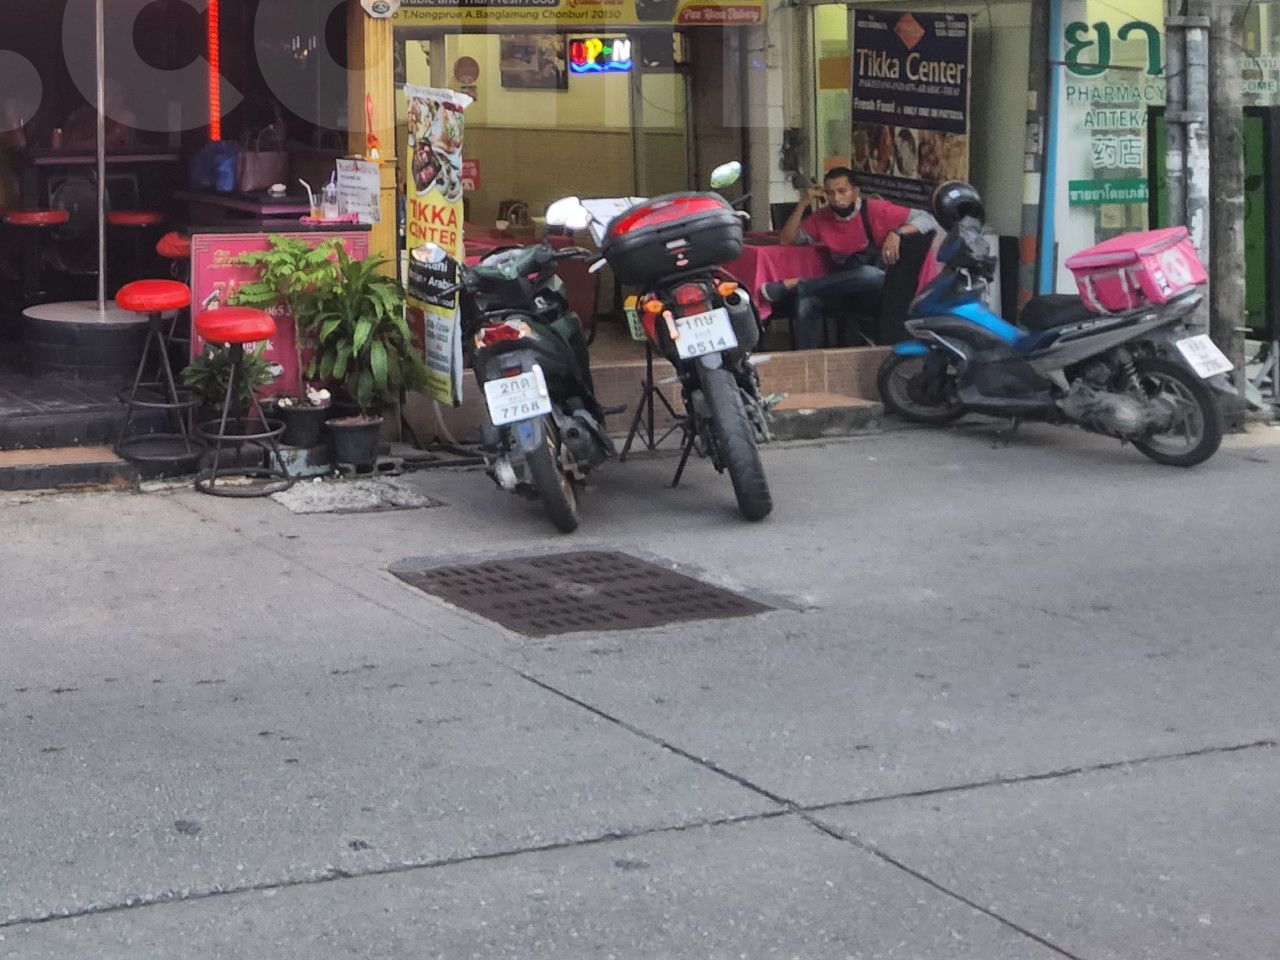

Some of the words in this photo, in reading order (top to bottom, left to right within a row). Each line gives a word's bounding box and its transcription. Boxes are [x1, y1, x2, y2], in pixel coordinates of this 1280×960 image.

[403, 9, 462, 21] T.Nongprue
[465, 9, 539, 21] A.Banglamung
[542, 10, 588, 19] Chonburi
[1064, 21, 1167, 77] ยา
[857, 48, 900, 79] Tikka
[906, 52, 965, 84] Center
[1066, 85, 1167, 102] PHARMACY
[1091, 136, 1143, 169] 药店
